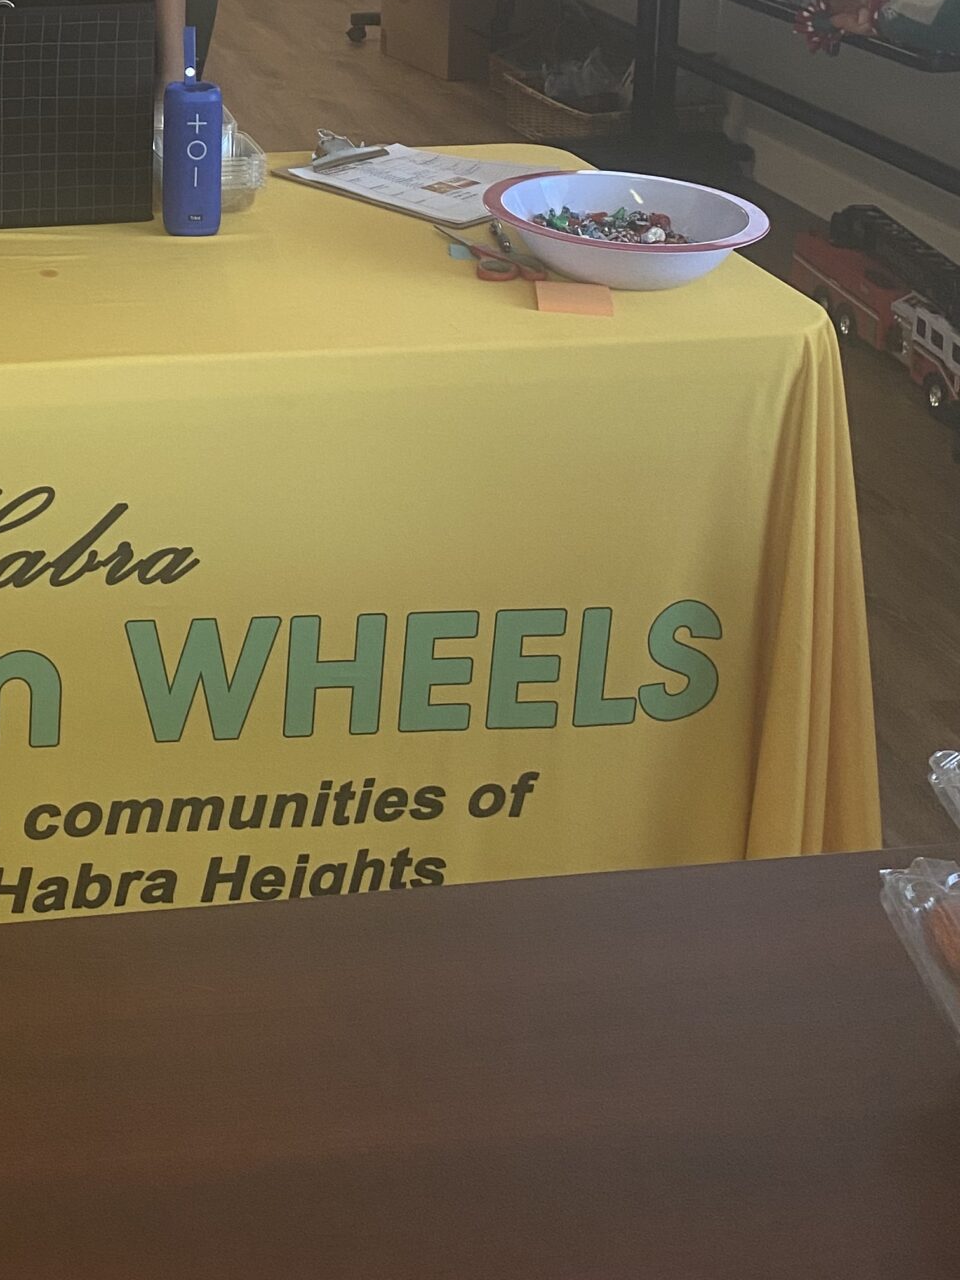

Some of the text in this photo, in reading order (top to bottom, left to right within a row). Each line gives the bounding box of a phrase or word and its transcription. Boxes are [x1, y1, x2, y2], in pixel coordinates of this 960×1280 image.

[125, 599, 722, 743] WHEELS
[23, 777, 446, 842] communities
[467, 772, 540, 819] of
[200, 847, 447, 904] Heights
